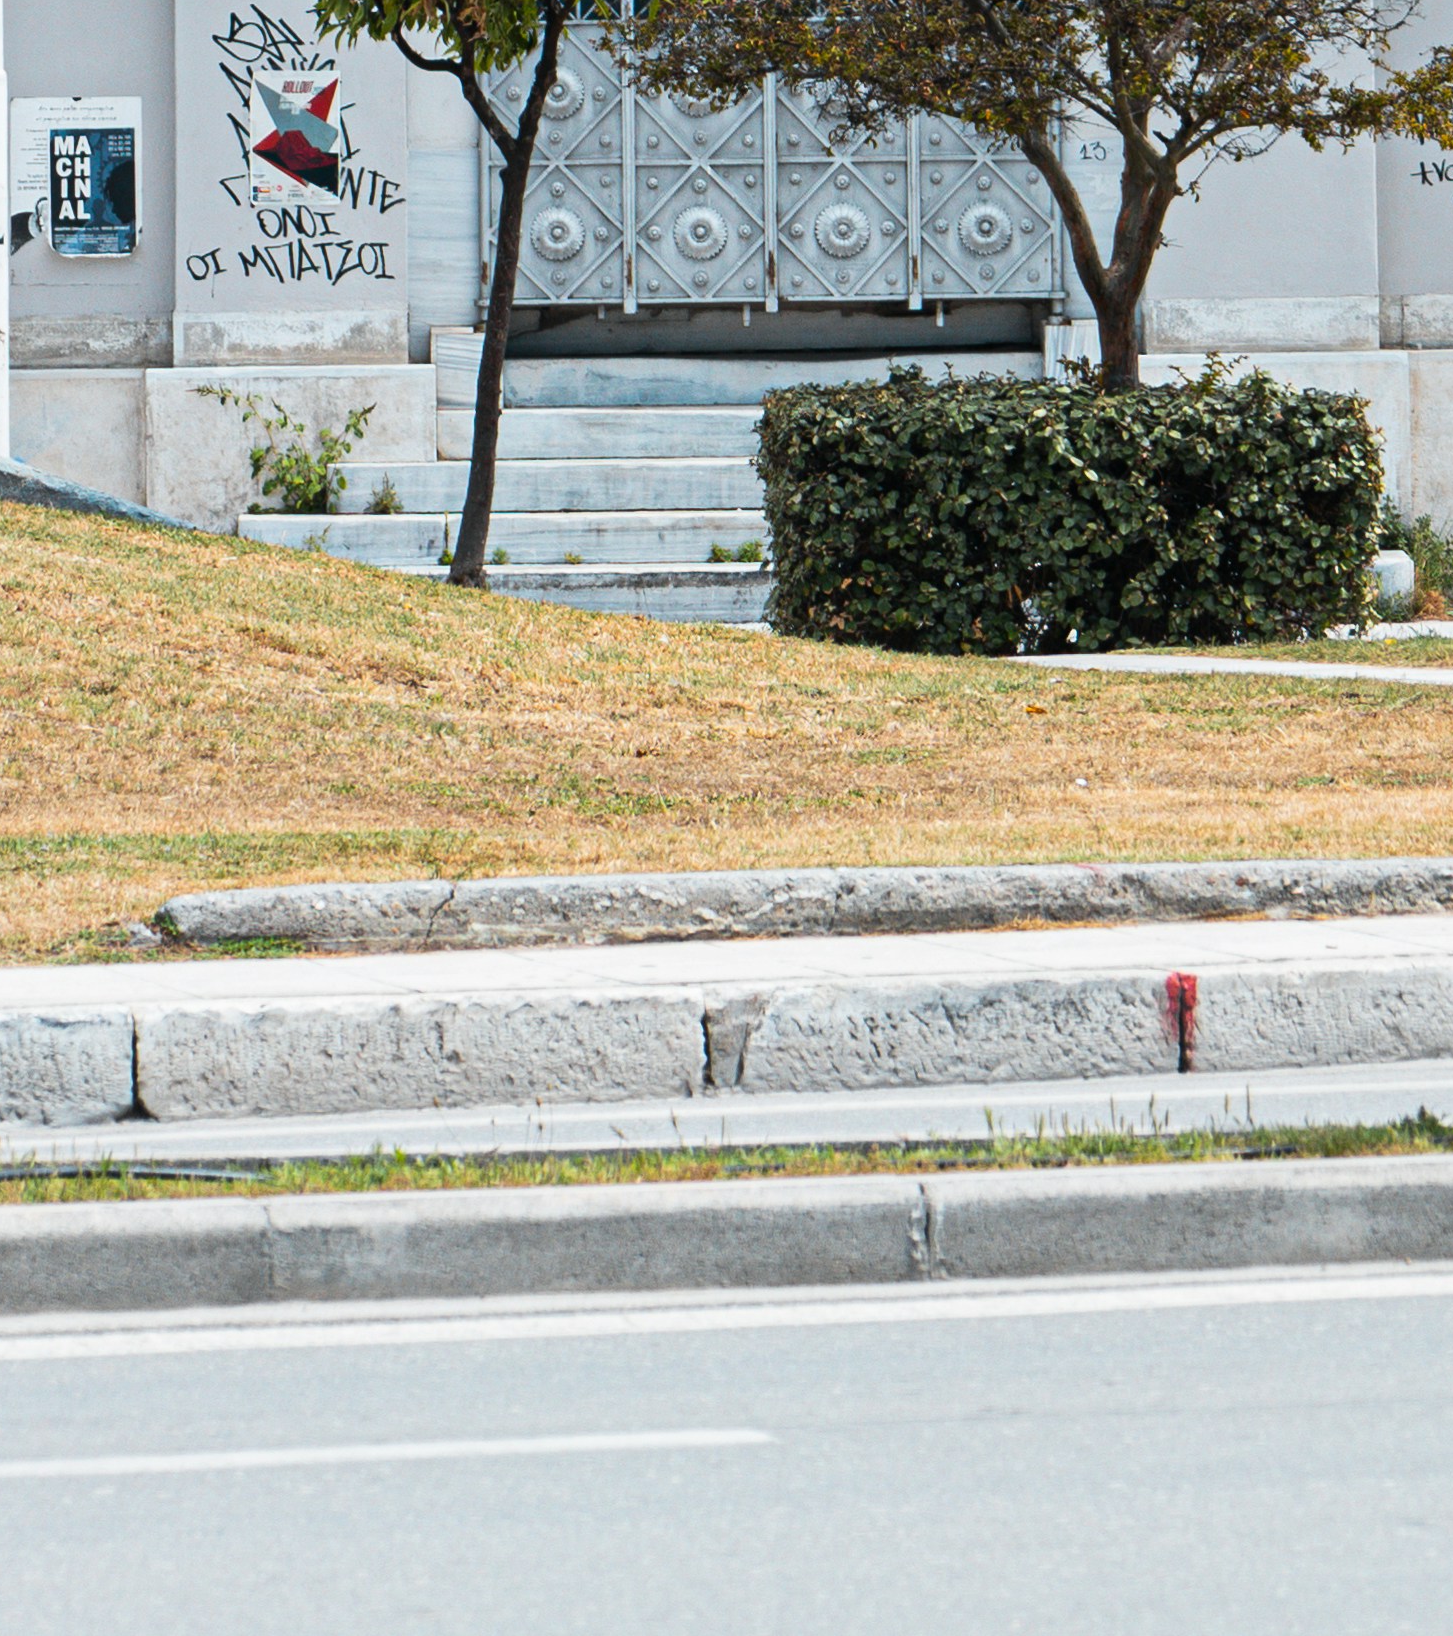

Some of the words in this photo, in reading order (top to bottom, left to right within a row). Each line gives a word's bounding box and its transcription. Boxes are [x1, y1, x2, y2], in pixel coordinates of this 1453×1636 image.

[53, 135, 93, 156] MA
[55, 156, 91, 178] CH
[60, 177, 92, 199] IN
[58, 198, 92, 220] AL
